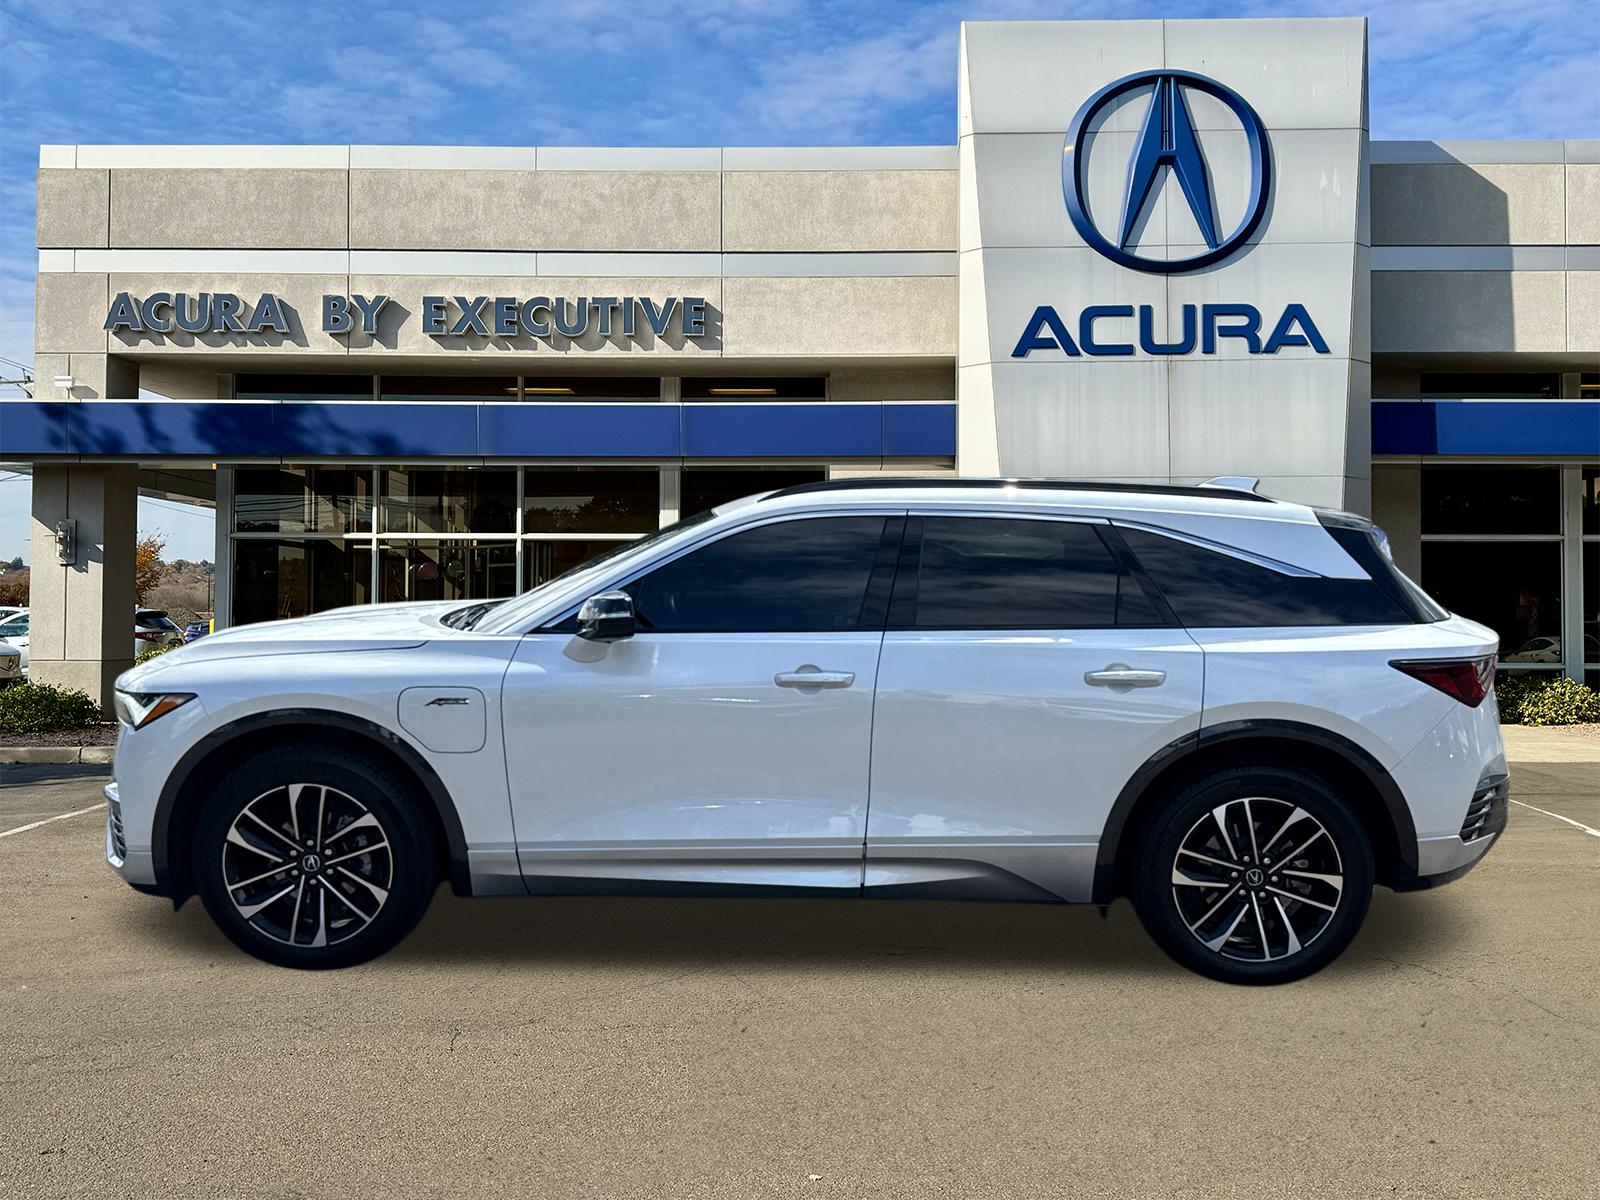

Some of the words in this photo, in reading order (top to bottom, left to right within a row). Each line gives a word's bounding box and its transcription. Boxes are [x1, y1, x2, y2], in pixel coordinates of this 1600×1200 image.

[103, 292, 289, 333] ACURA
[322, 294, 389, 334] BY
[422, 296, 706, 336] EXECUTIVE
[1010, 303, 1331, 357] ACURA
